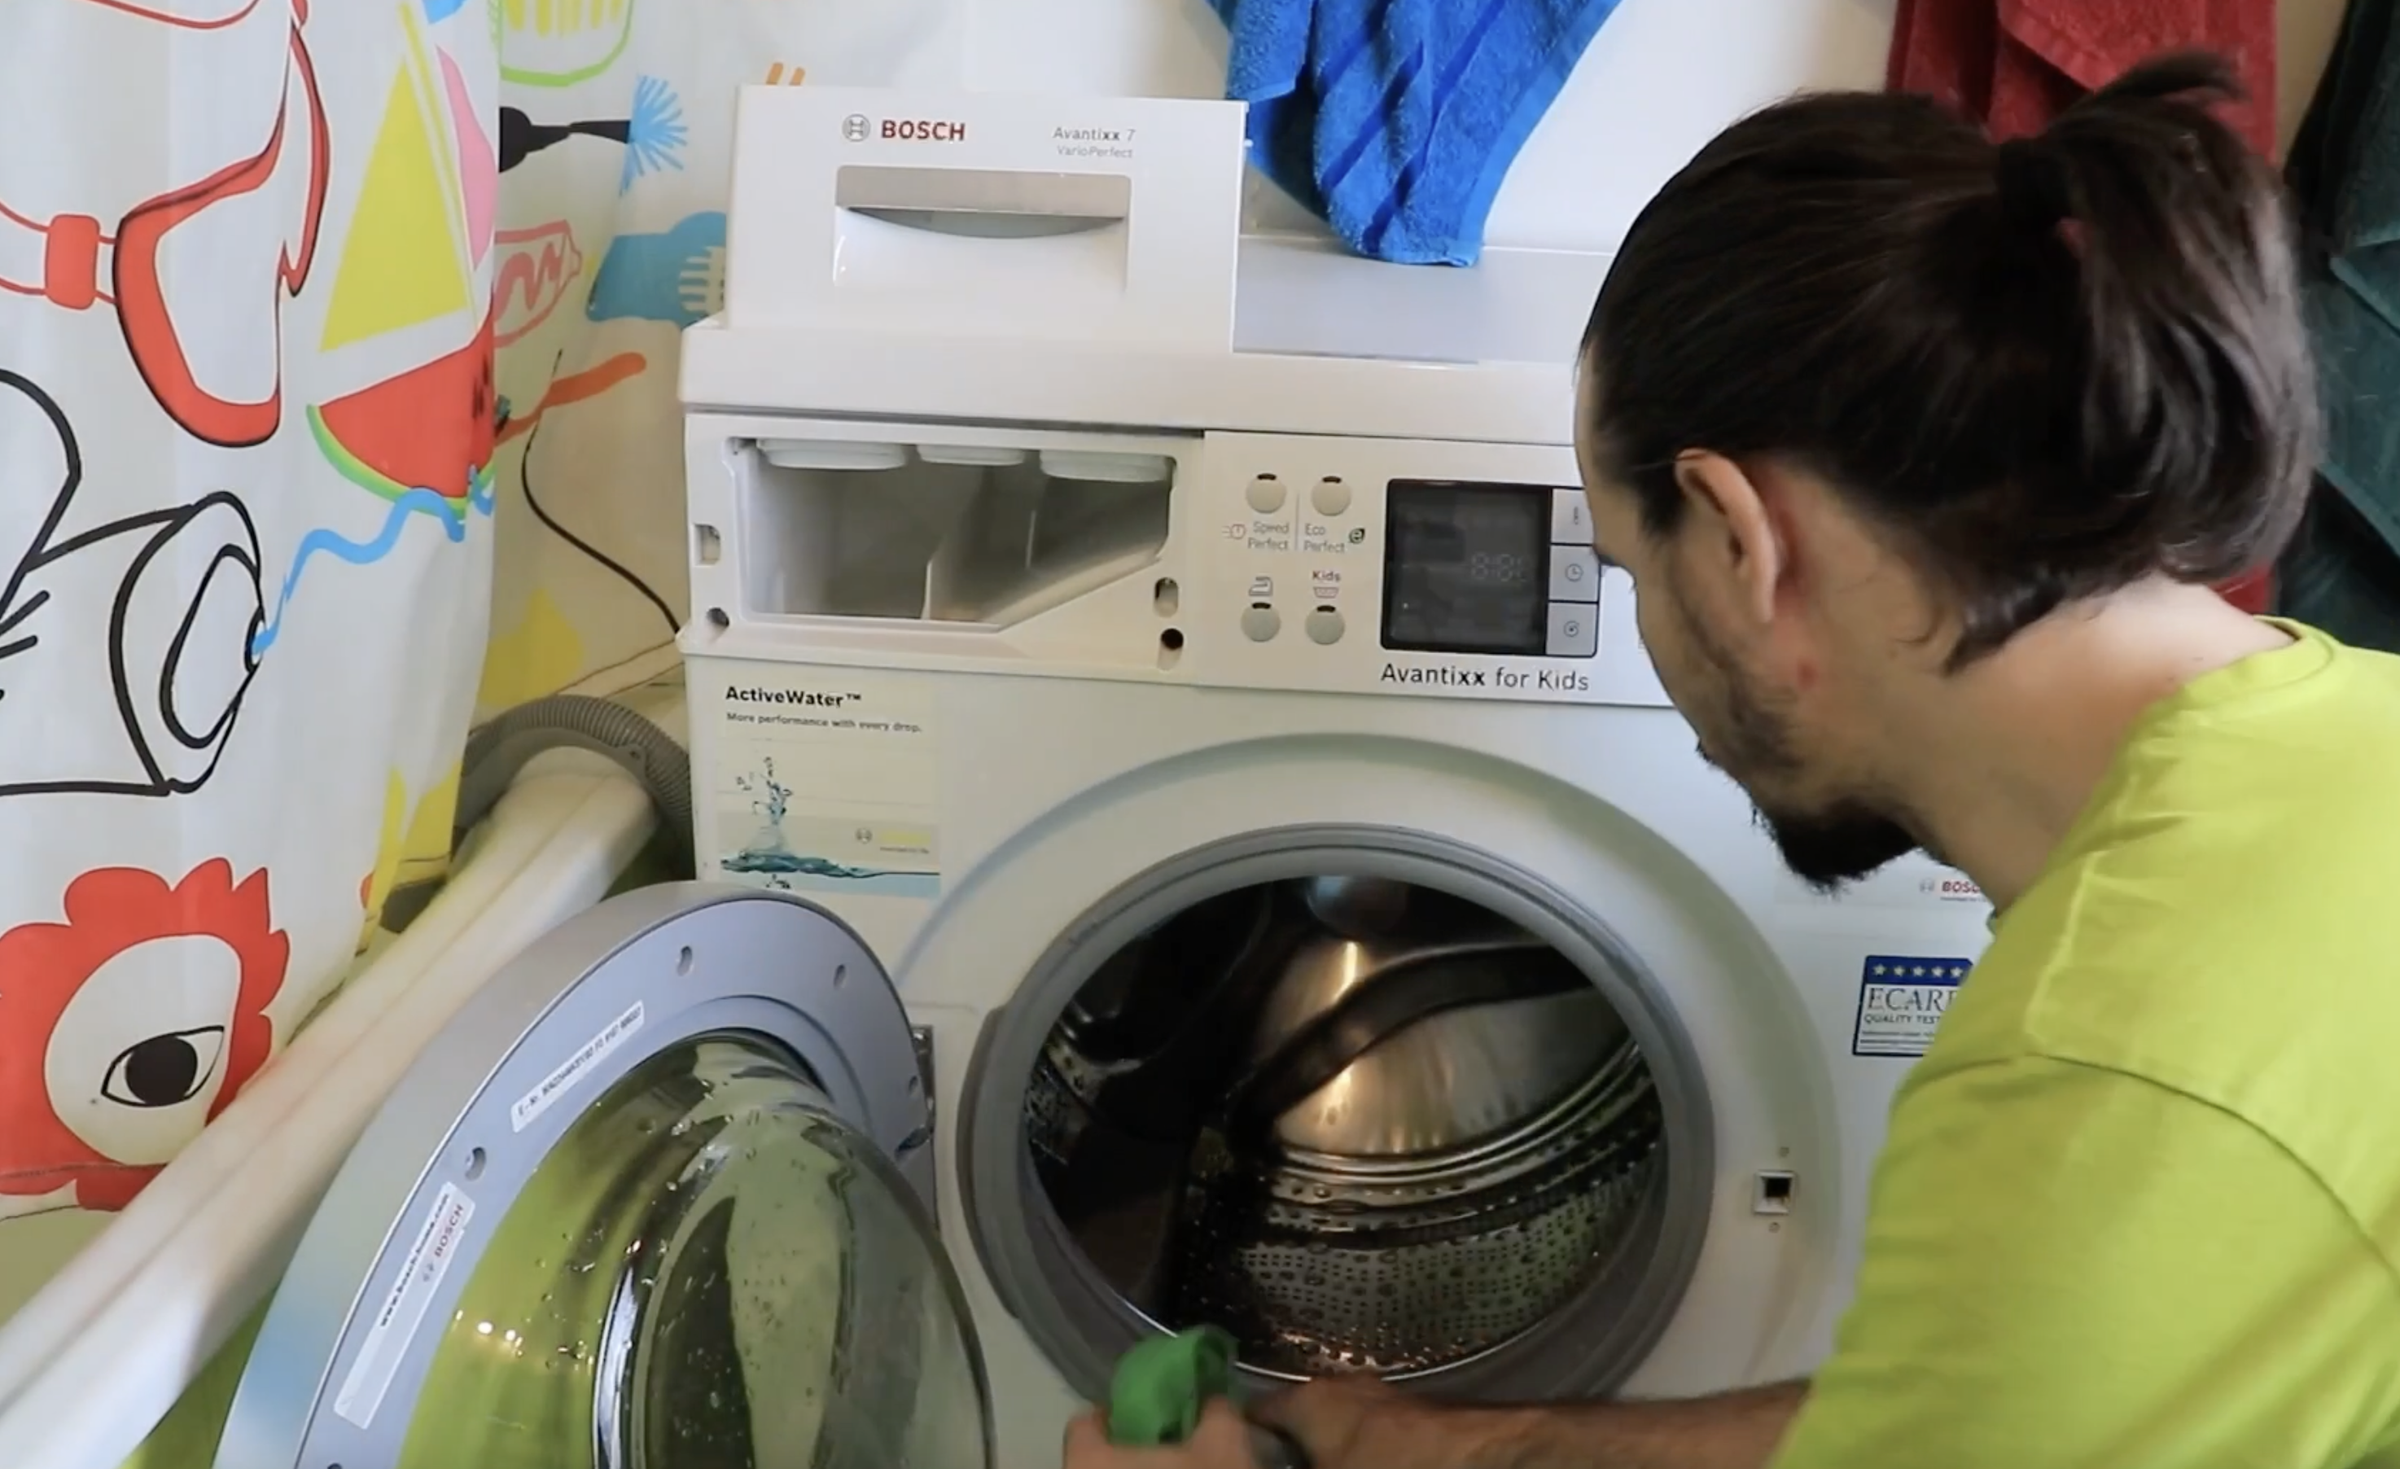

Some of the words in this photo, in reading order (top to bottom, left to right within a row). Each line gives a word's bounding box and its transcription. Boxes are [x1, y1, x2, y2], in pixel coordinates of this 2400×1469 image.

[881, 120, 965, 141] BOSCH
[1052, 126, 1120, 142] Avantixx
[1126, 129, 1136, 142] 7
[1252, 521, 1290, 537] Speed
[1305, 524, 1326, 537] Eco
[1248, 537, 1289, 552] Perfect
[1304, 539, 1345, 554] Perfect
[1312, 570, 1341, 583] Kids
[1381, 662, 1486, 687] Avantixx
[1496, 666, 1529, 689] for
[1538, 669, 1590, 691] Kids
[727, 711, 755, 723] More
[757, 714, 829, 728] performance
[831, 719, 855, 729] with
[859, 722, 889, 733] every
[893, 721, 923, 734] drop.
[1941, 881, 1980, 894] BOSC
[1864, 1014, 1911, 1025] QUALITY
[434, 1204, 465, 1257] BOSCH
